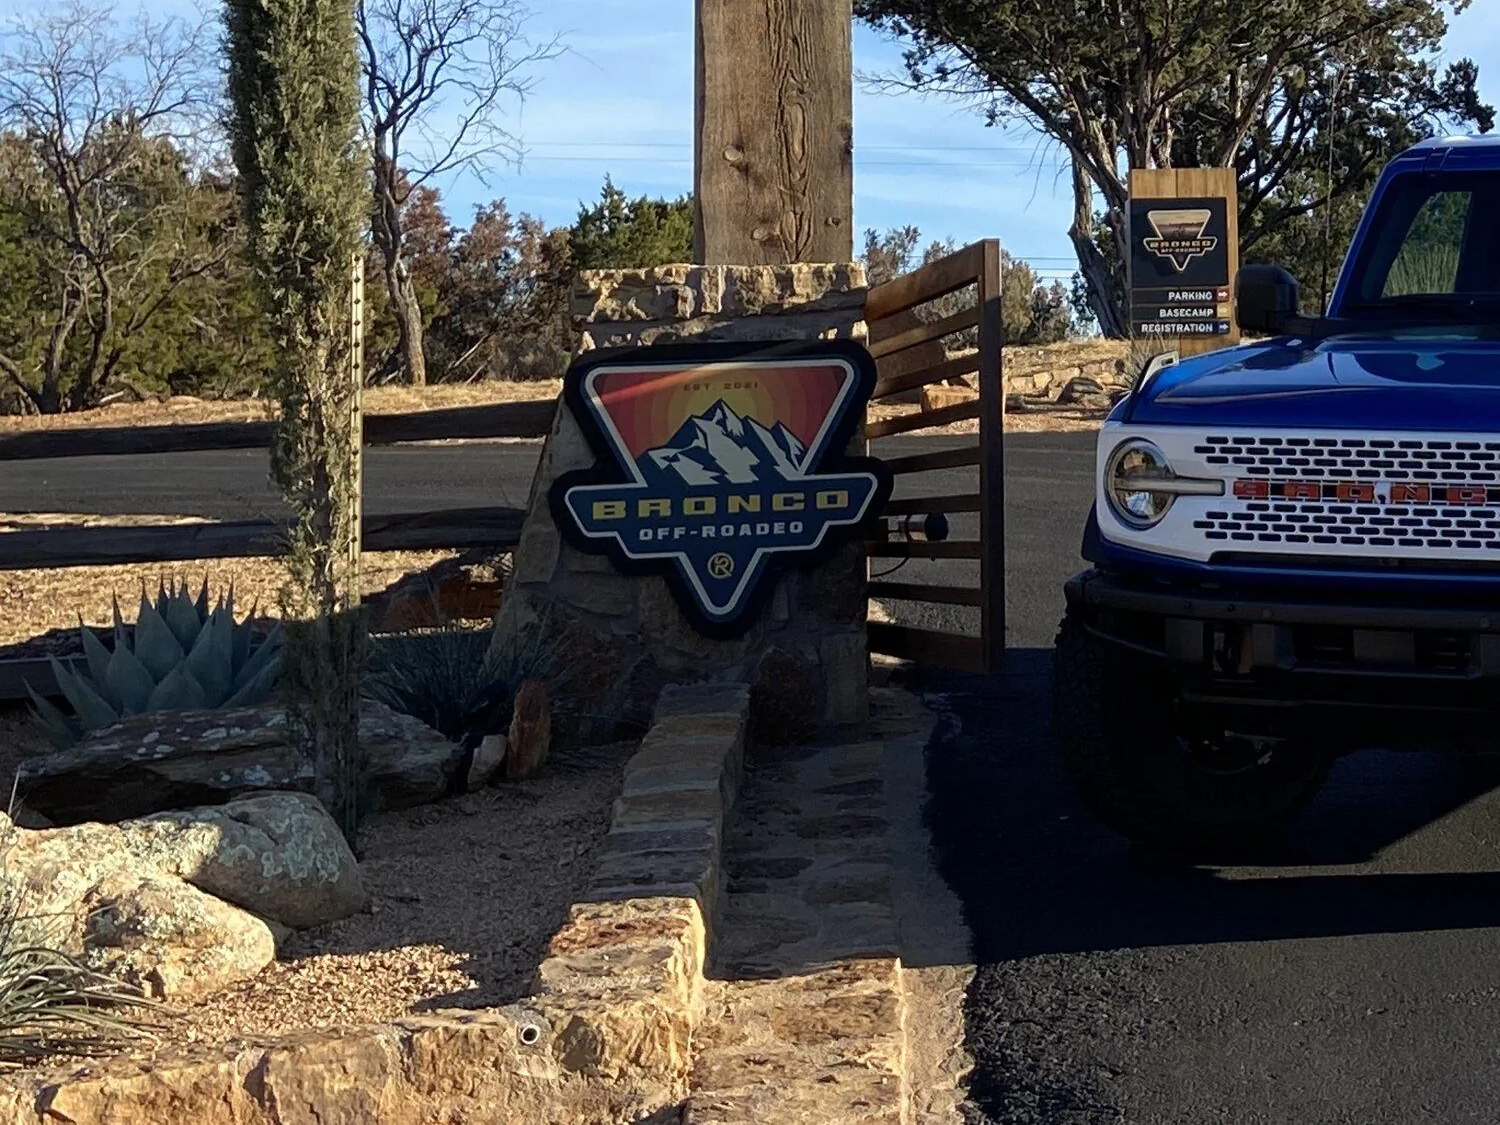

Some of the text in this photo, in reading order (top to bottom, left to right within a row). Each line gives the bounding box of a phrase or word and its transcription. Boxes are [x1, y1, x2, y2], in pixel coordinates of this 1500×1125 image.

[1168, 291, 1213, 301] PARKING
[1159, 308, 1214, 318] BASECAMP
[1141, 323, 1213, 333] REGISTRATION
[592, 490, 849, 520] BRONCO
[638, 520, 804, 542] OFF-ROADEO
